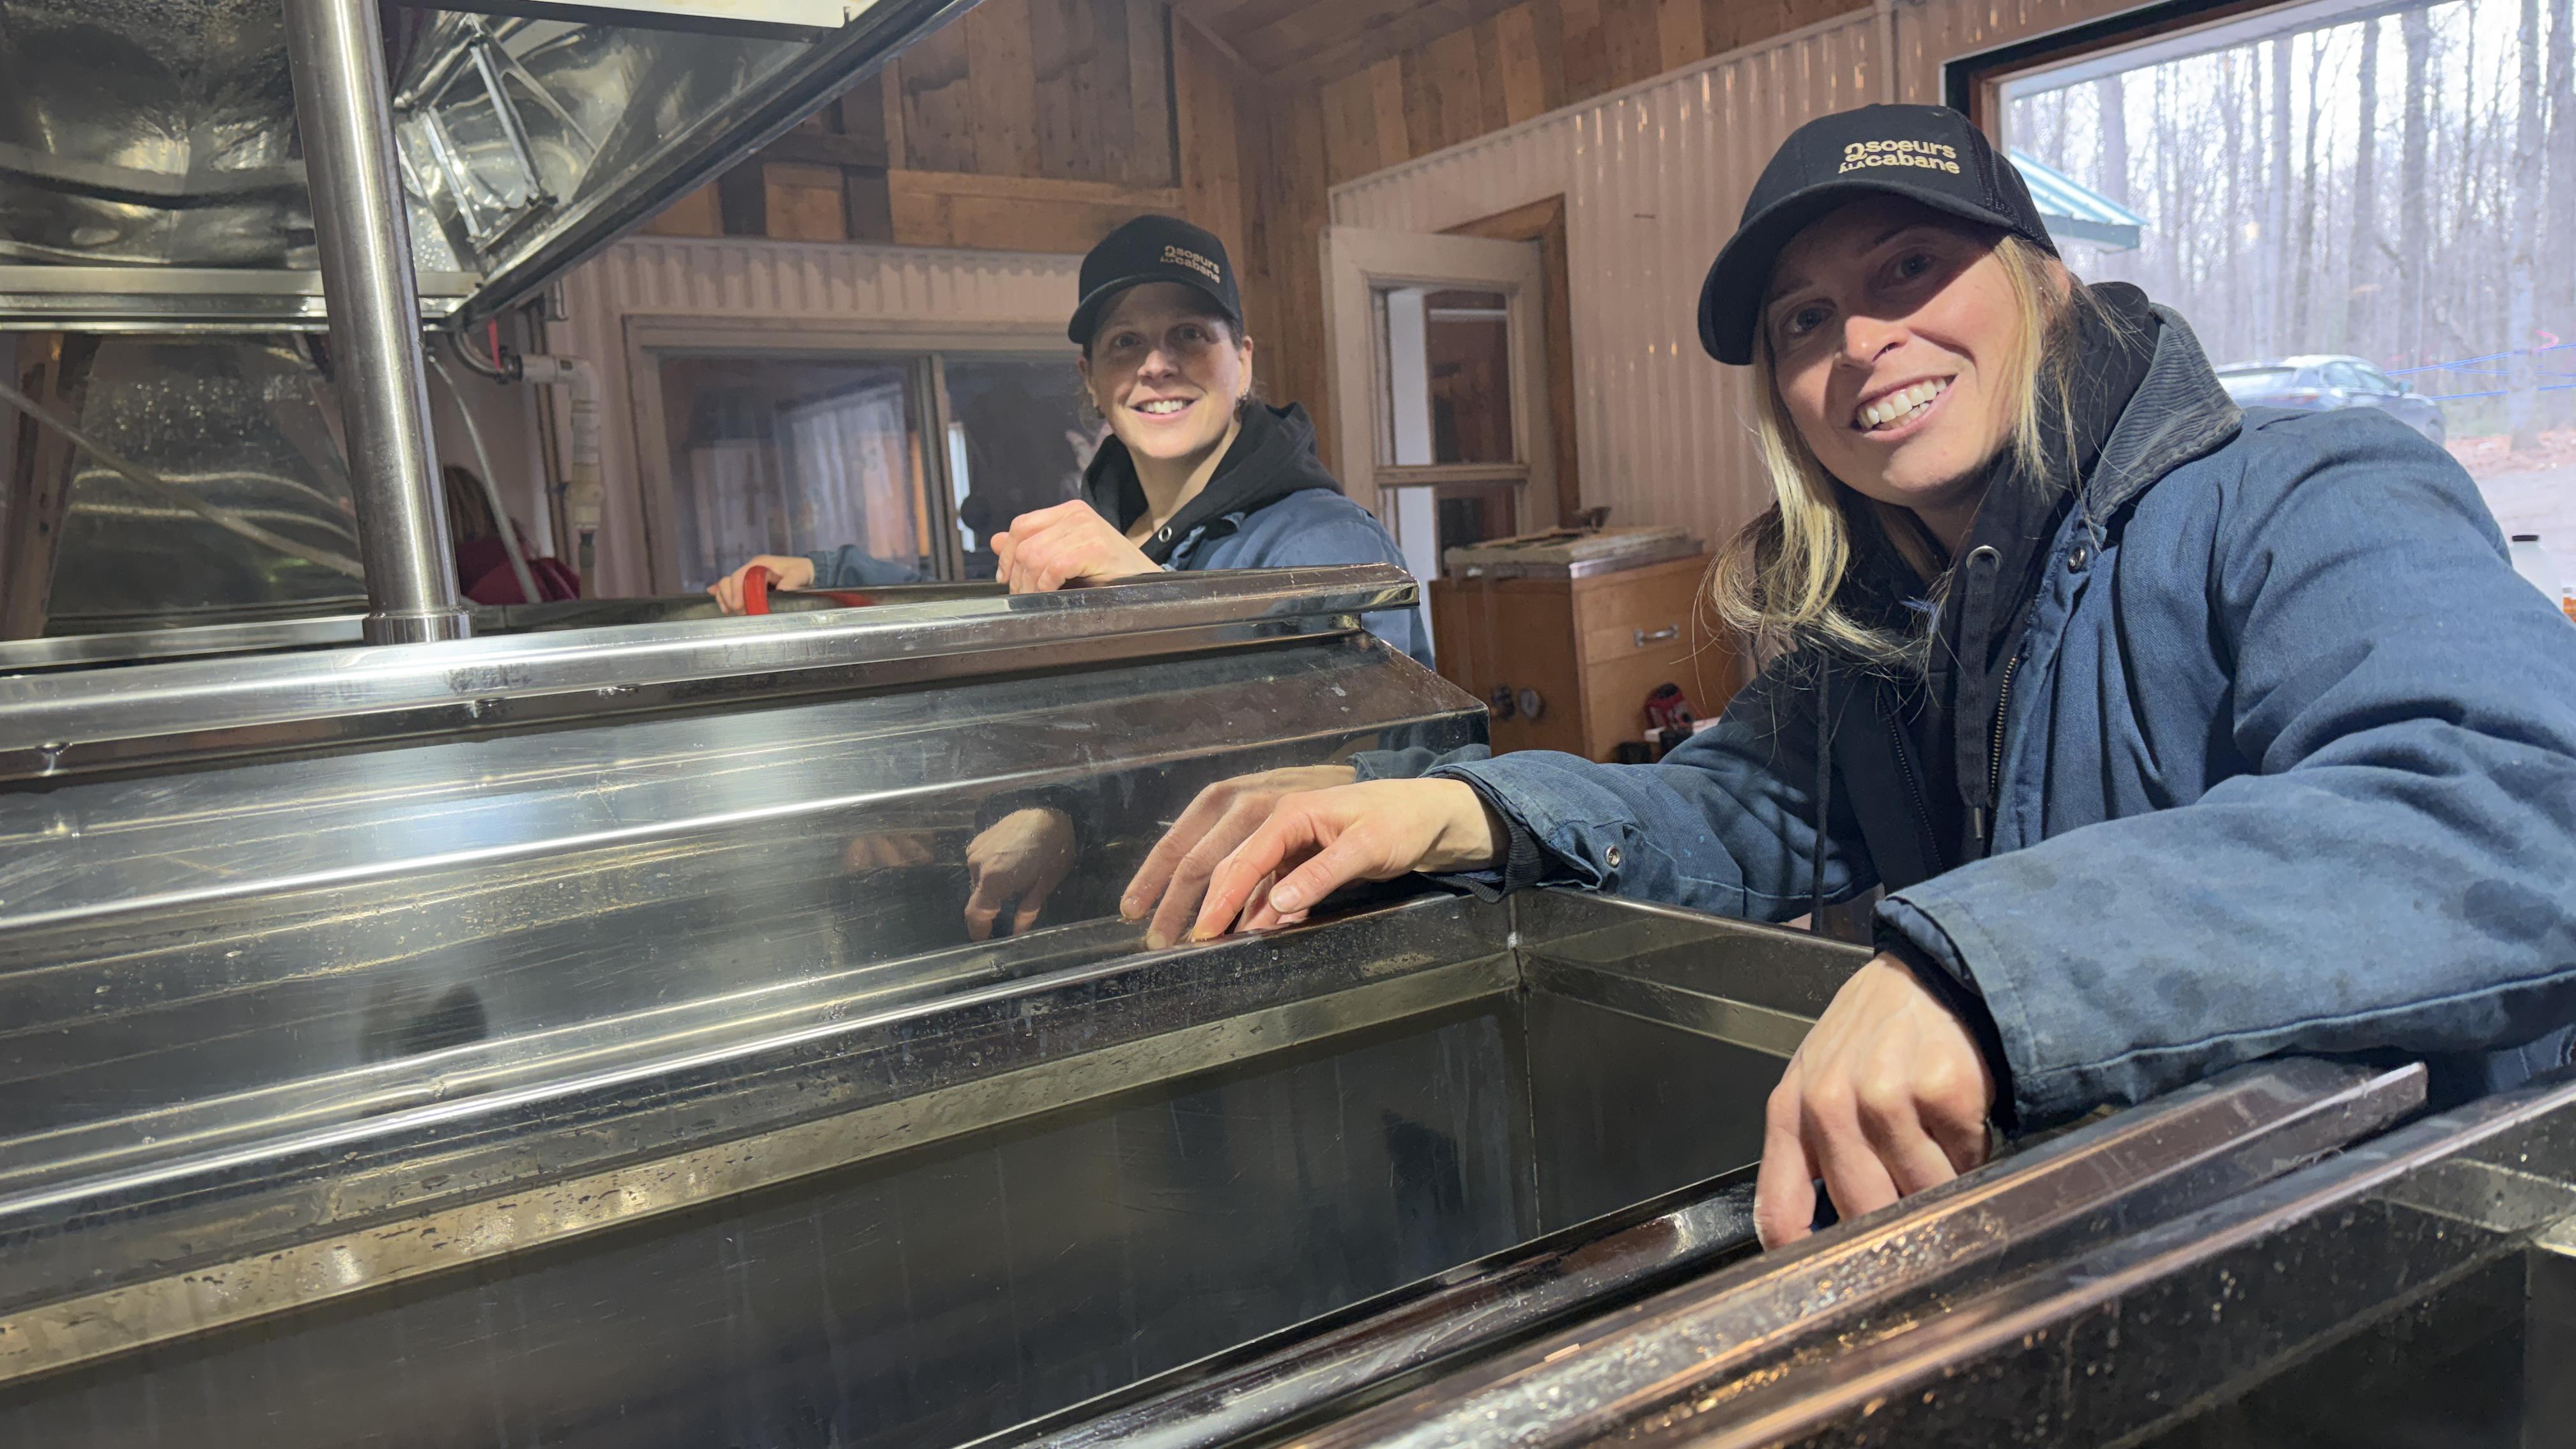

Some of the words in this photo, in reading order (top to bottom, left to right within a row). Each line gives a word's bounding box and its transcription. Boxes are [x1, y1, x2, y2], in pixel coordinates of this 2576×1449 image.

[1844, 142, 1867, 162] 2
[1865, 140, 1956, 159] soeurs
[1865, 150, 1960, 174] cabane
[1165, 245, 1177, 257] 2
